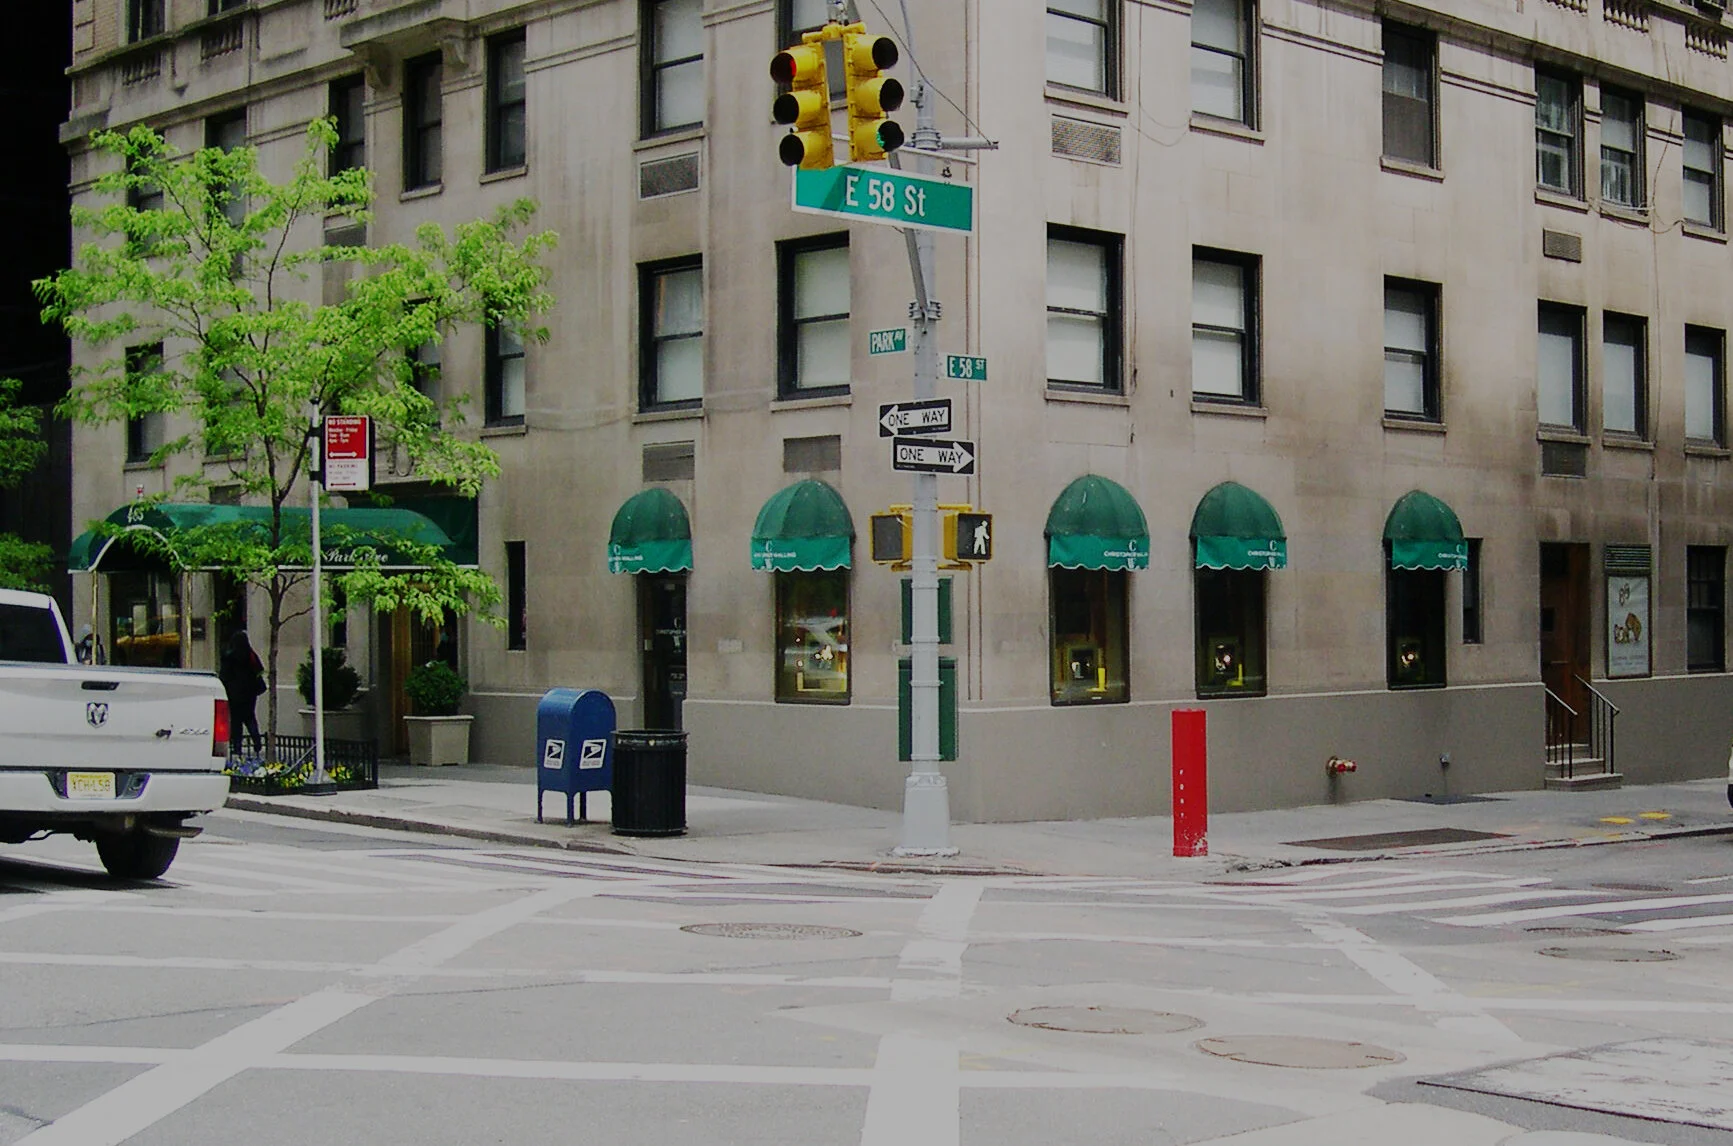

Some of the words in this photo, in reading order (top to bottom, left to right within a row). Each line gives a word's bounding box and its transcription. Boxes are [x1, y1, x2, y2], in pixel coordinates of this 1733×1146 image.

[846, 175, 859, 207] E
[868, 179, 895, 212] 58
[904, 184, 926, 217] St
[871, 332, 895, 353] PARK
[894, 330, 904, 341] AV
[949, 356, 956, 376] E
[959, 358, 972, 378] 58
[975, 360, 985, 370] ST
[888, 412, 909, 427] ONE
[922, 409, 945, 424] WAY
[900, 447, 924, 461] ONE
[938, 450, 963, 464] WAY
